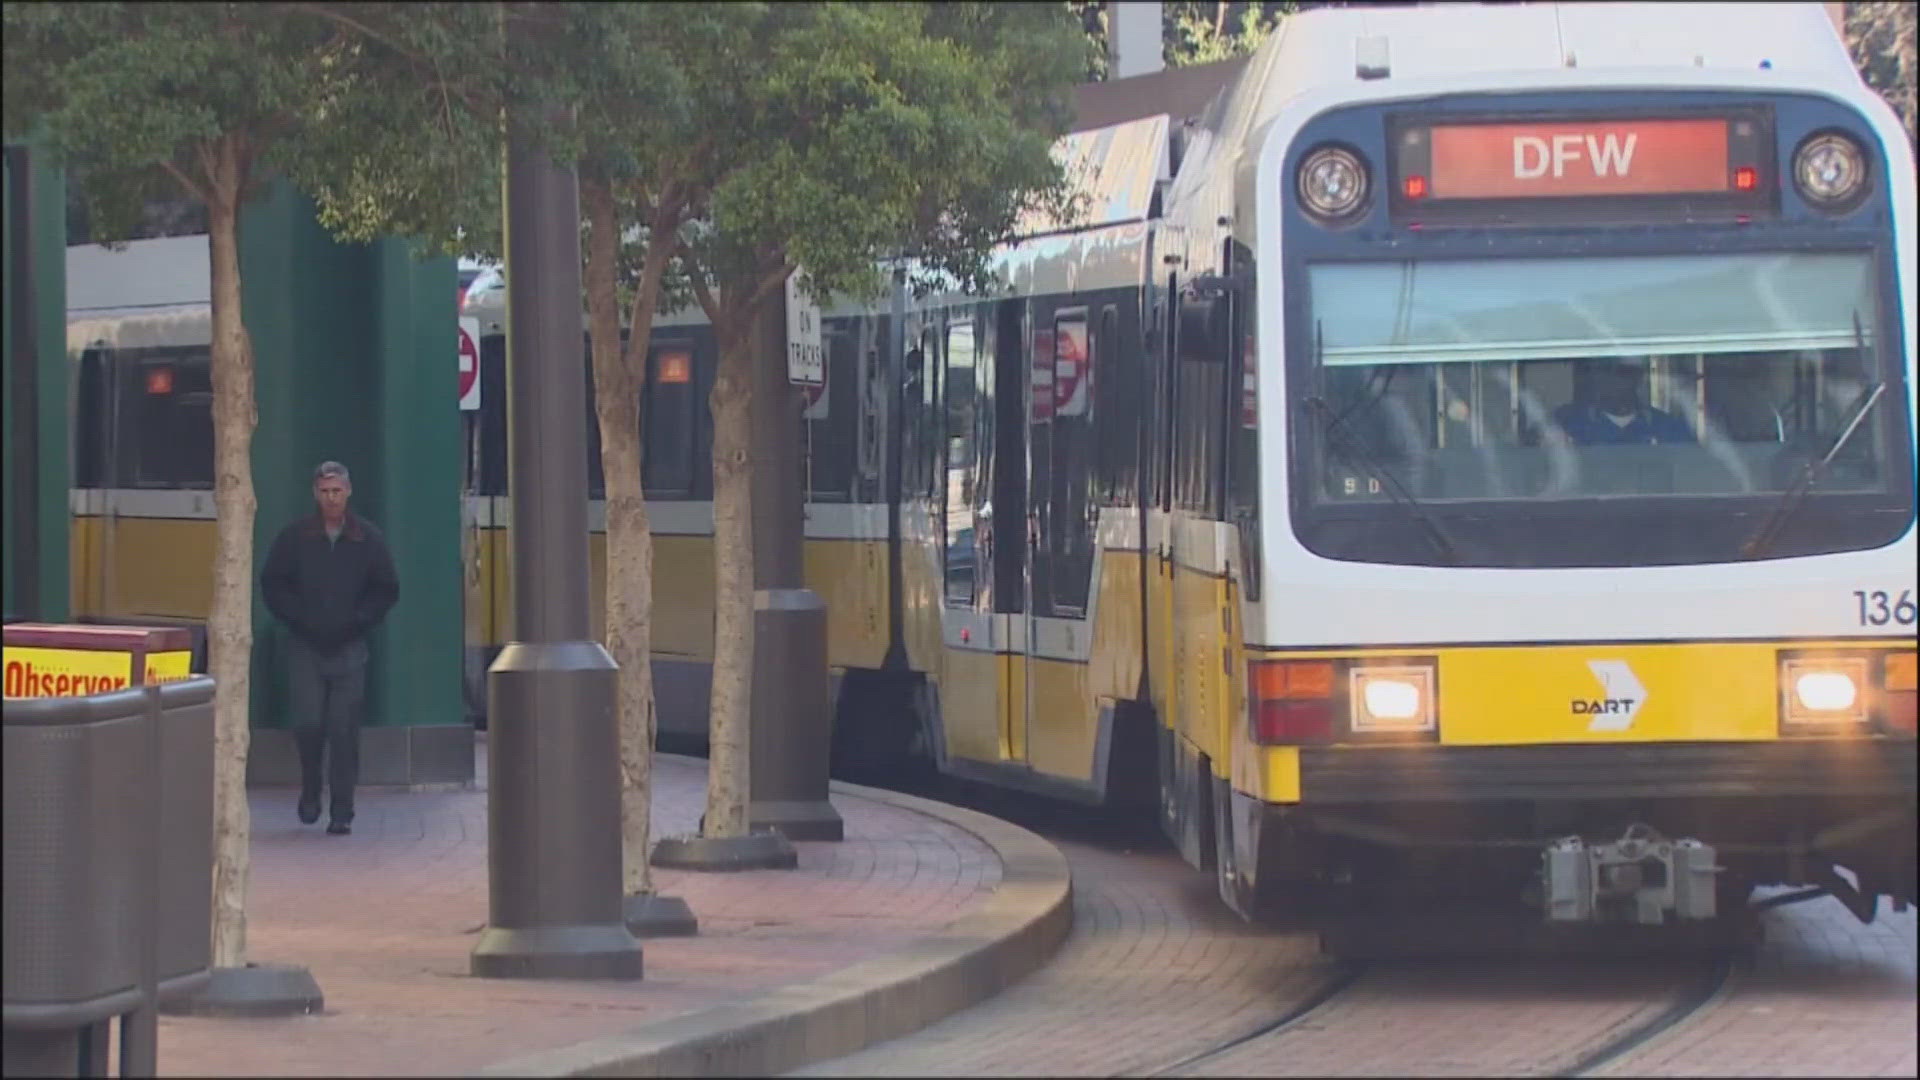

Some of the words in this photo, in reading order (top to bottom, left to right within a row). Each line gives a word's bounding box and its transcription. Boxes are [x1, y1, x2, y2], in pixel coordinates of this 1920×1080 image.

[1512, 133, 1637, 179] DFW
[799, 311, 811, 333] ON
[791, 342, 821, 367] TRACKS
[1853, 589, 1917, 626] 136
[5, 661, 125, 698] Observer
[1571, 699, 1634, 715] DART
